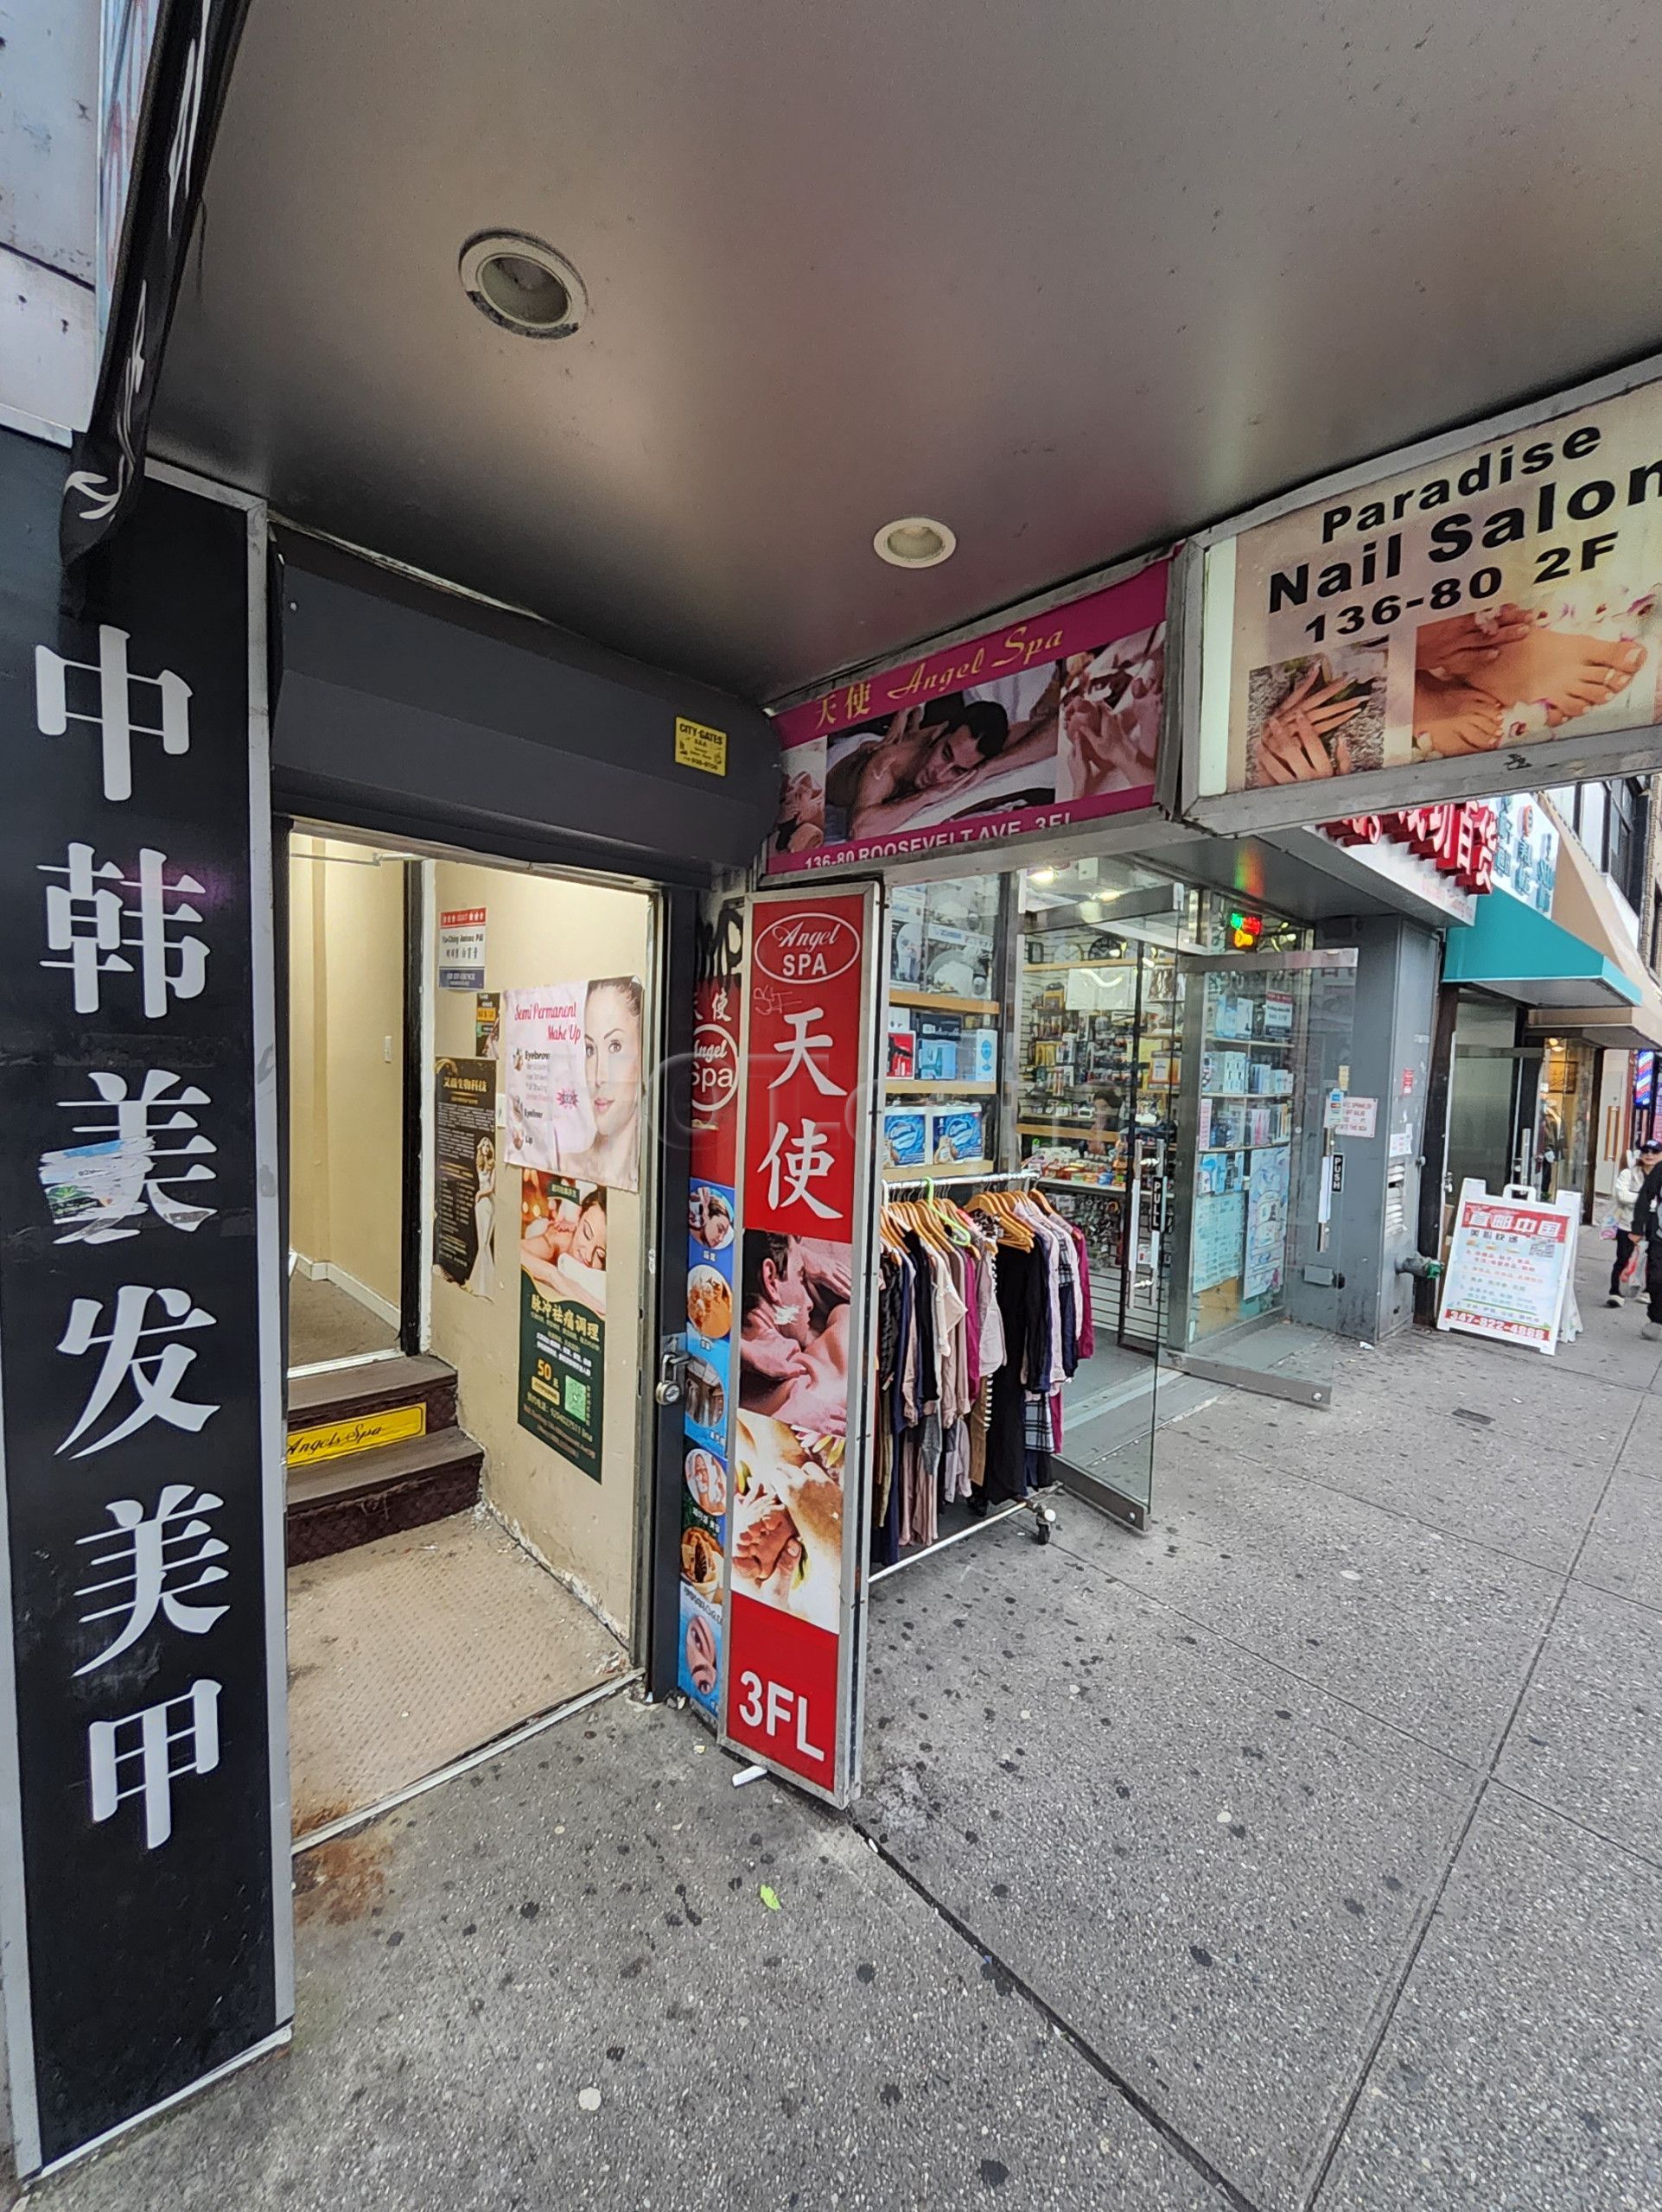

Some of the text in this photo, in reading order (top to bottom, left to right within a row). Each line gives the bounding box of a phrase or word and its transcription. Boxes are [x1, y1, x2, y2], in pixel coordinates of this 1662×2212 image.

[1322, 426, 1601, 544] Paradise
[1268, 532, 1403, 613] Nail
[1304, 530, 1620, 643] 136-80 2F
[815, 626, 1063, 730] 天使 Angel Spa
[772, 921, 840, 953] Angel
[782, 953, 827, 976] SPA
[514, 1001, 532, 1021] Semi
[532, 1001, 577, 1020] Permanent
[547, 1024, 582, 1044] Make Up
[757, 1007, 848, 1219] 天使
[1333, 1157, 1341, 1190] PUSH
[1152, 1180, 1162, 1227] PULL
[35, 624, 231, 1850] 中韩美发美甲
[538, 1357, 552, 1381] 50
[346, 1423, 383, 1445] Spa
[739, 1670, 825, 1762] 3FL
